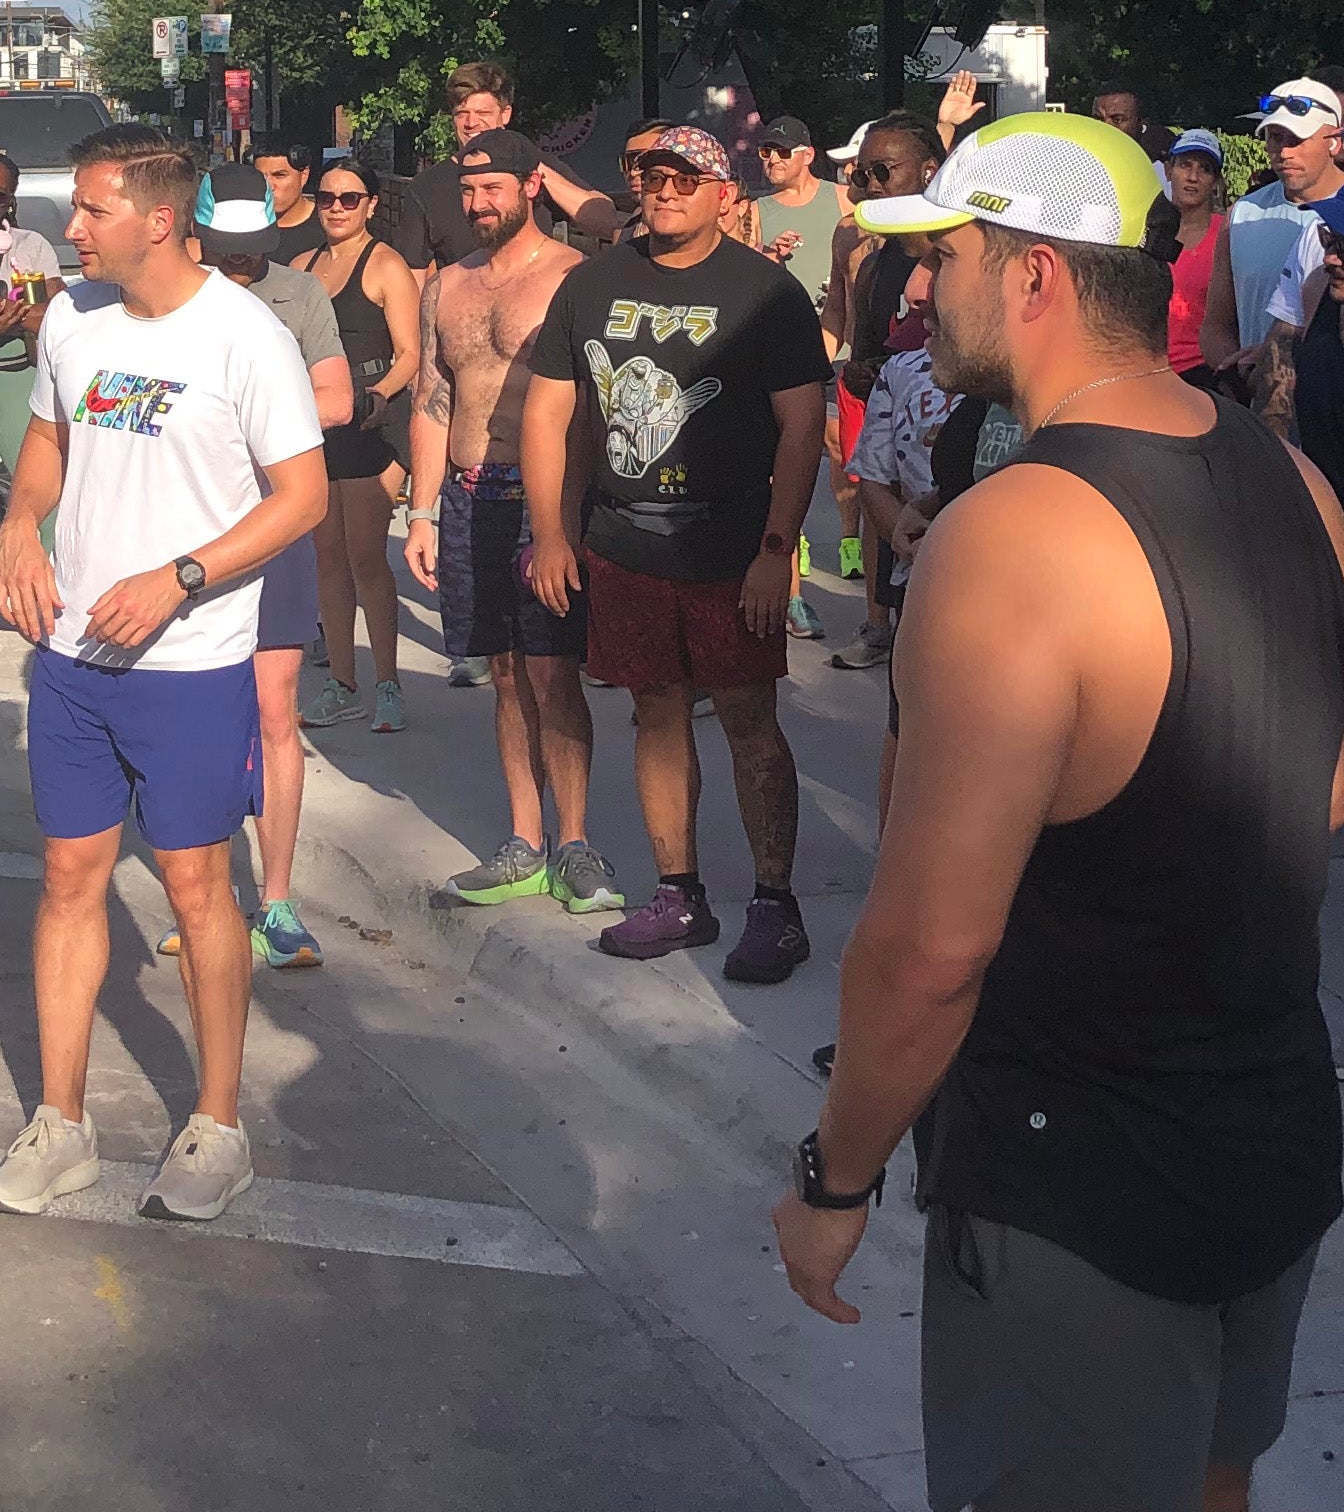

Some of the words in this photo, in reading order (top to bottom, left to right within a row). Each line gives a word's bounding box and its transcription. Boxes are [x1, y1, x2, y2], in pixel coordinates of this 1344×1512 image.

[605, 298, 719, 348] ゴジラ
[72, 369, 188, 438] NIKE
